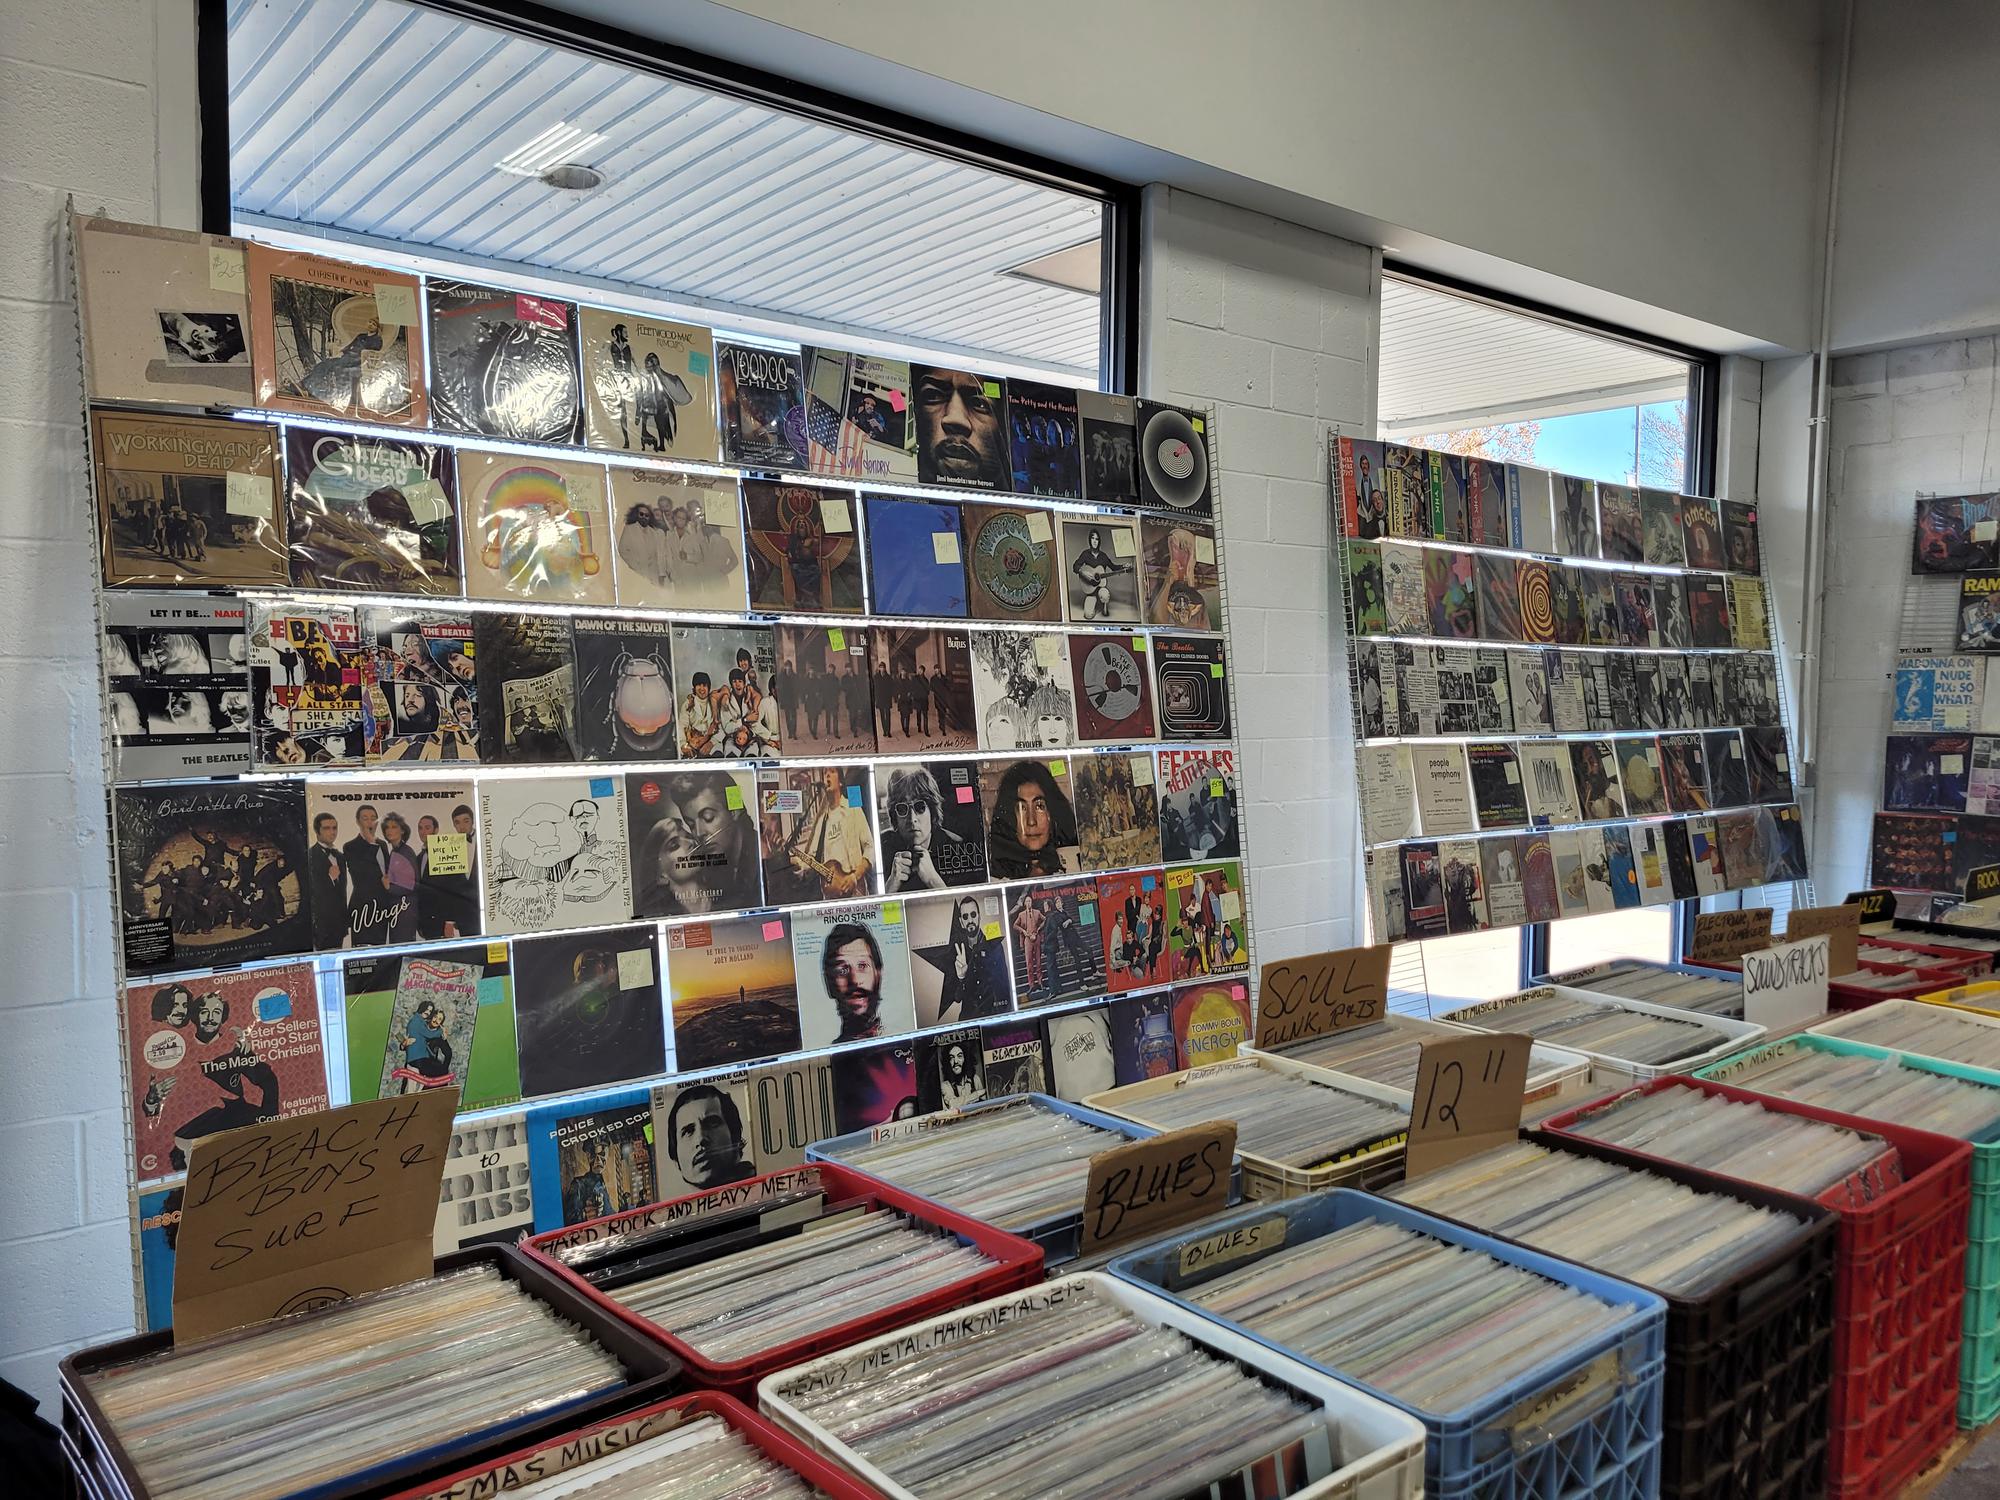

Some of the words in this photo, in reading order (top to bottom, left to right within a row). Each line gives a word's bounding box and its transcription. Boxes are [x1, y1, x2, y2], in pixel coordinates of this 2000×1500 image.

[448, 289, 492, 301] SAMPLER
[730, 348, 788, 388] VOODOO
[737, 379, 788, 391] CHILD
[1008, 395, 1020, 404] Tom
[107, 431, 267, 463] WORKINGMAN'S
[184, 453, 234, 470] DEAD
[356, 464, 408, 485] DEAD
[632, 468, 681, 488] Grateful
[977, 479, 994, 487] heroes
[1061, 511, 1076, 520] BOB
[1079, 512, 1100, 522] WEIR
[1684, 506, 1718, 533] OMEGA
[150, 609, 169, 618] LET
[171, 609, 182, 618] IT
[186, 609, 211, 618] BE...
[214, 609, 245, 618] NAKE
[526, 616, 542, 624] The
[543, 617, 570, 625] Beatle
[423, 627, 439, 636] THE
[527, 630, 542, 639] Tony
[575, 619, 604, 631] DAWN
[606, 620, 620, 632] OF
[620, 621, 635, 632] THE
[636, 622, 664, 633] SILVER
[1156, 642, 1169, 651] The
[1171, 642, 1195, 652] Beatles
[1119, 653, 1132, 669] THE
[1897, 658, 1955, 669] MADONNA
[1957, 657, 1975, 668] ON
[1111, 657, 1132, 684] BEATLES
[1940, 670, 1972, 681] NUDE
[535, 681, 554, 692] BEAT
[1934, 682, 1957, 693] PIX:
[1959, 682, 1975, 692] SO
[306, 700, 325, 709] ALL
[330, 700, 354, 709] STAR
[307, 711, 334, 720] SHEA
[1015, 740, 1043, 749] REVOLVER
[182, 755, 203, 765] THE
[205, 753, 250, 764] BEATLES
[1429, 757, 1450, 770] people
[1430, 770, 1462, 781] symphony
[365, 791, 399, 801] NIGHT
[616, 790, 624, 818] Wings
[197, 803, 212, 813] on
[482, 794, 492, 817] Paul
[618, 819, 626, 839] over
[484, 818, 494, 869] McCartney
[937, 842, 983, 858] LENNON
[938, 854, 984, 870] LEGEND
[487, 869, 495, 888] and
[1977, 867, 2000, 890] ROCK
[623, 886, 632, 907] 1972
[690, 888, 724, 899] McCartney
[487, 890, 497, 922] Wings
[816, 907, 835, 917] BLAST
[835, 906, 853, 915] FROM
[853, 904, 868, 913] YOUR
[350, 895, 411, 935] Wings
[823, 914, 850, 925] RINGO
[851, 911, 877, 921] STARR
[124, 928, 147, 936] LIMITED
[147, 925, 169, 934] EDITION
[128, 921, 165, 931] ANNIVERSARY
[714, 947, 726, 955] TRUE
[713, 955, 728, 965] JOEY
[213, 972, 251, 985] original
[253, 967, 285, 979] sound
[286, 963, 312, 974] track
[403, 978, 431, 989] MAGIC
[1263, 960, 1375, 1020] SOUL
[1470, 1001, 1493, 1019] MUSIC
[242, 1025, 275, 1041] Peter
[276, 1018, 318, 1033] Sellers
[1191, 1021, 1219, 1033] TOMMY
[1220, 1016, 1242, 1029] BOLIN
[1263, 1015, 1323, 1049] FUNK,
[251, 1036, 287, 1051] Ringo
[288, 1030, 319, 1044] Starr
[1183, 1030, 1238, 1056] ENERGY
[201, 1059, 227, 1074] The
[228, 1052, 267, 1069] Magic
[267, 1042, 321, 1062] Christian
[991, 1047, 1021, 1062] BLACK
[1021, 1041, 1041, 1054] AND
[1749, 1044, 1785, 1066] MUSIC
[676, 1078, 702, 1090] SIMON
[702, 1072, 733, 1084] BEFORE
[282, 1093, 327, 1111] featuring
[290, 1109, 298, 1118] &
[298, 1105, 315, 1116] Get
[549, 1117, 595, 1140] POLICE
[560, 1120, 625, 1149] CROOKED
[188, 1101, 421, 1210] BEACH
[480, 1152, 500, 1169] to
[233, 1147, 377, 1217] BOYS
[400, 1143, 437, 1170] &
[1092, 1140, 1223, 1241] BLUES
[457, 1188, 531, 1227] MASS
[542, 1227, 599, 1255] HARD
[607, 1210, 656, 1236] ROCK
[666, 1202, 693, 1221] AND
[696, 1186, 752, 1215] HEAVY
[208, 1194, 380, 1272] SURF
[1186, 1226, 1261, 1267] BLUES
[933, 1318, 975, 1349] HAIR
[561, 1421, 653, 1467] MUSIC
